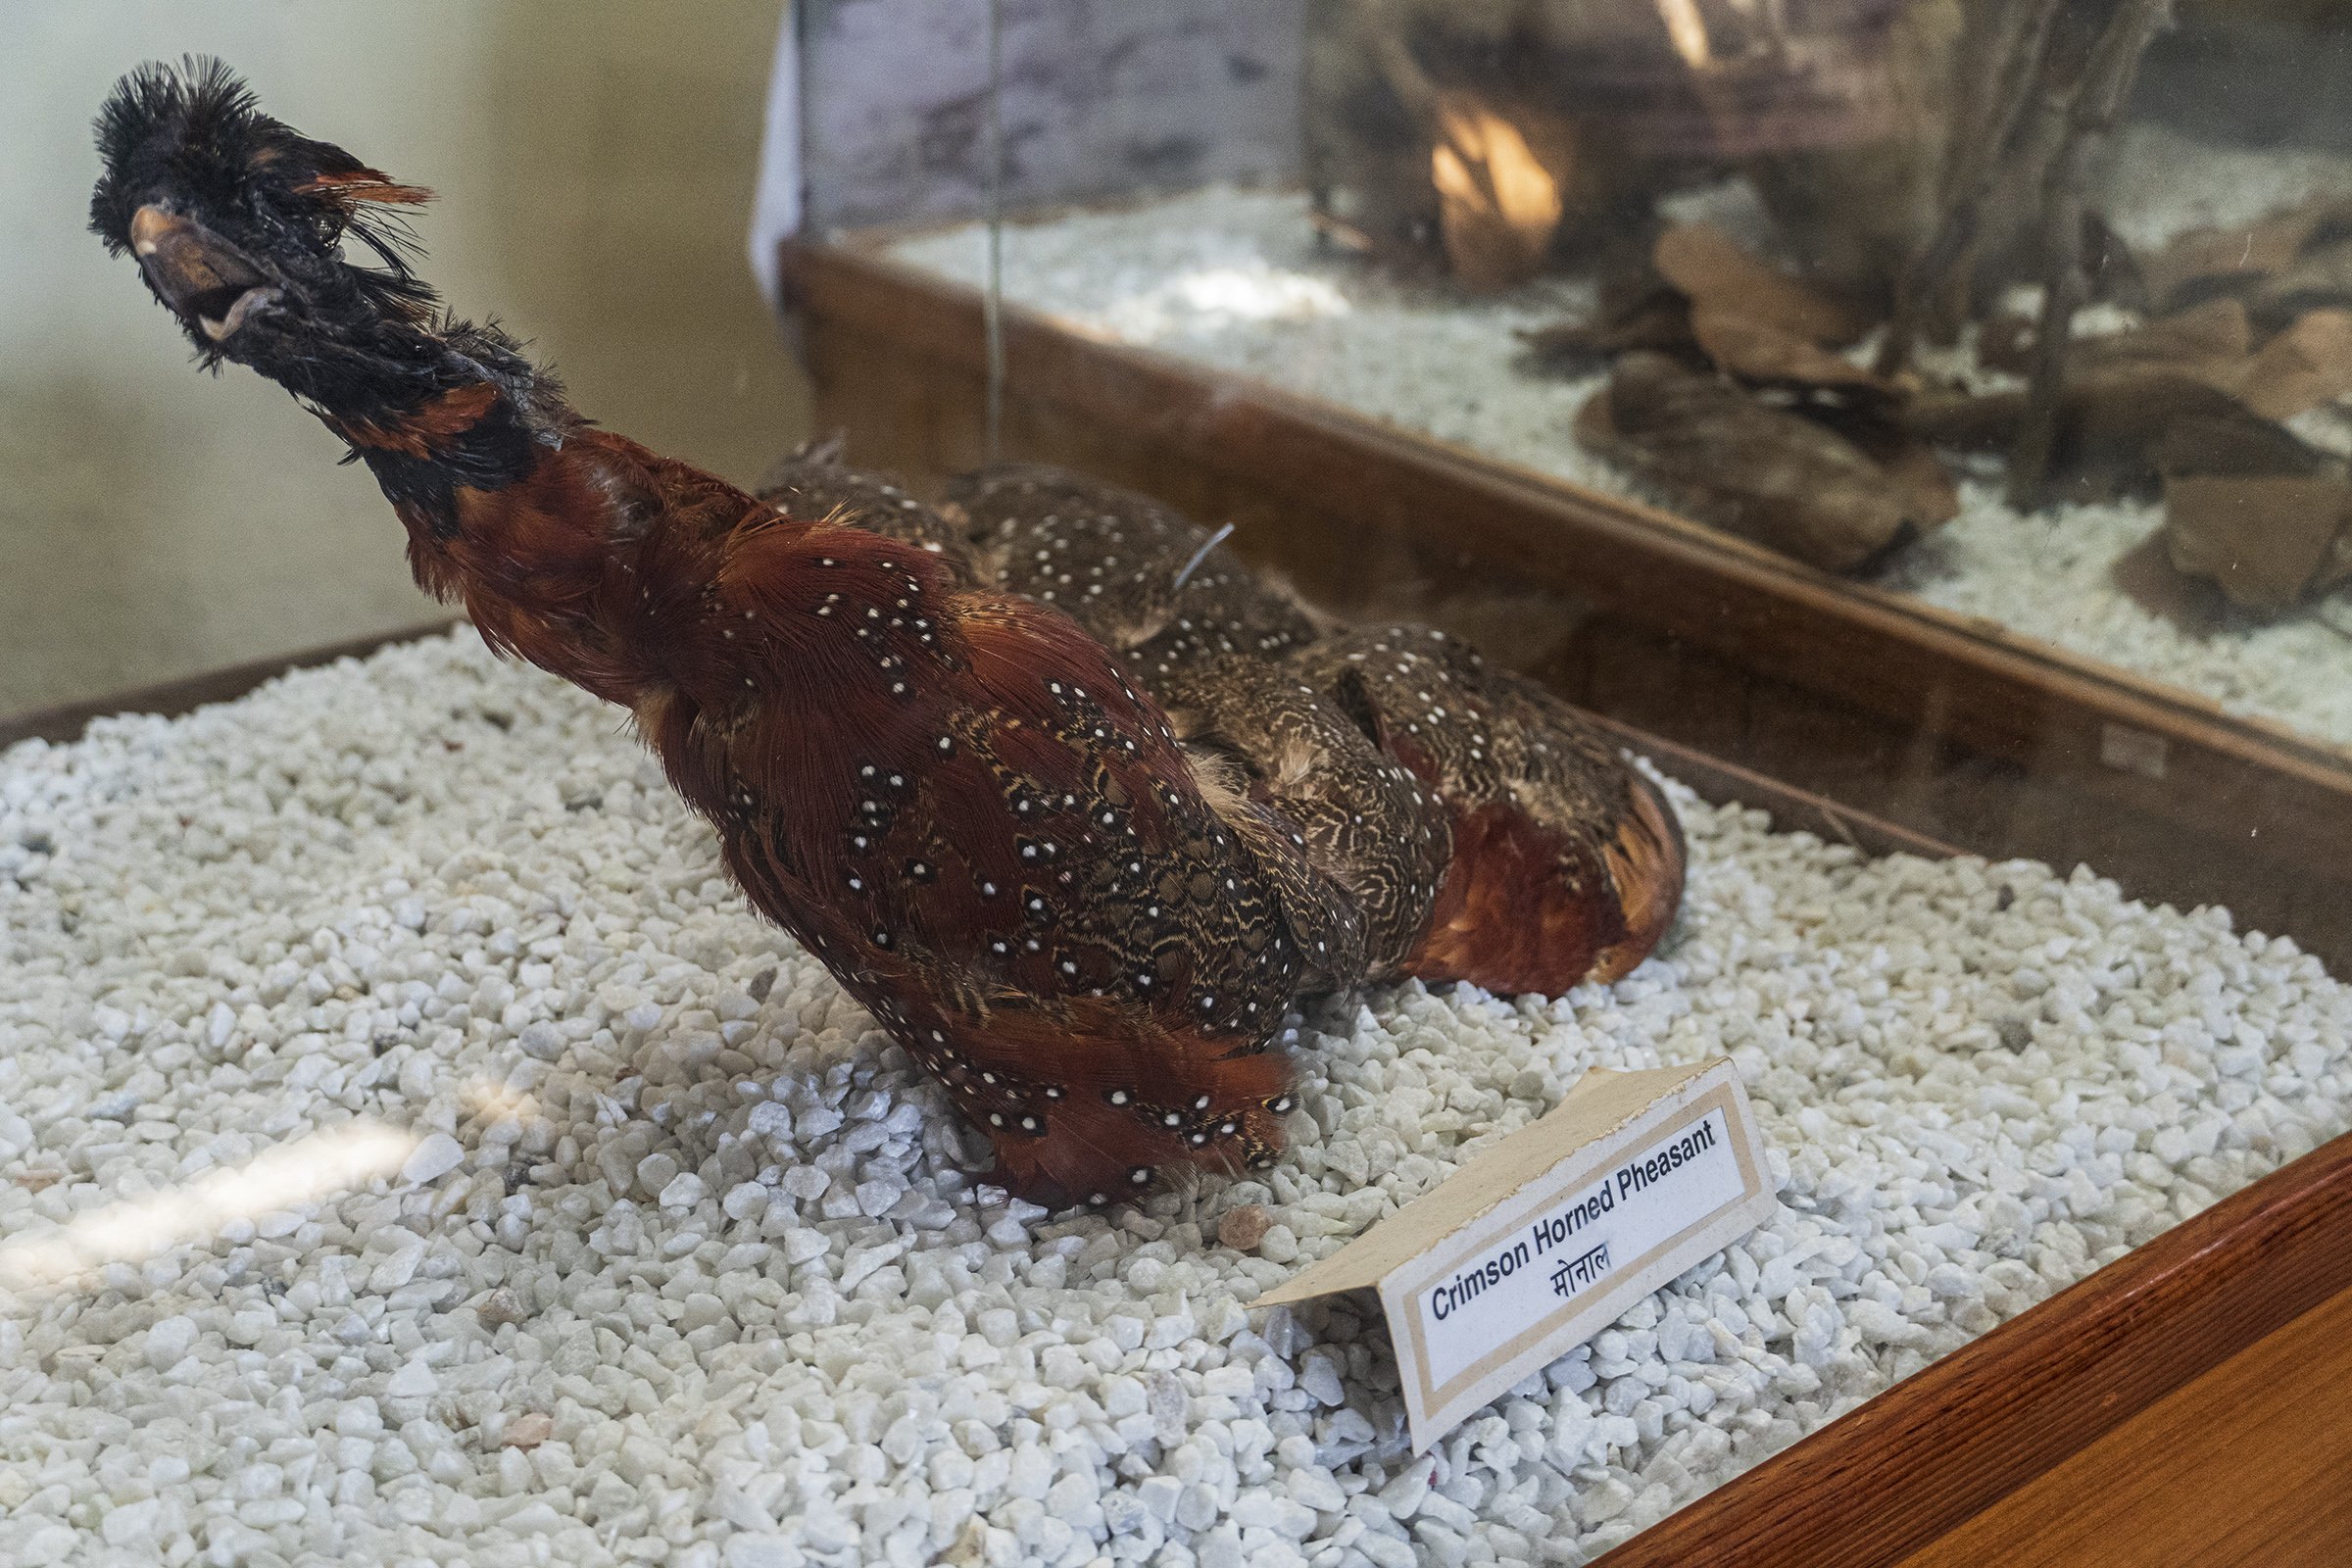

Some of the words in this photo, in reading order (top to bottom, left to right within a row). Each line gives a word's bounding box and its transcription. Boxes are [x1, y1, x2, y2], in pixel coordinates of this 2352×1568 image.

[1432, 1241, 1530, 1320] Crimson
[1533, 1180, 1615, 1255] Horned
[1617, 1120, 1716, 1201] Pheasant
[1549, 1240, 1611, 1298] मोनाल
